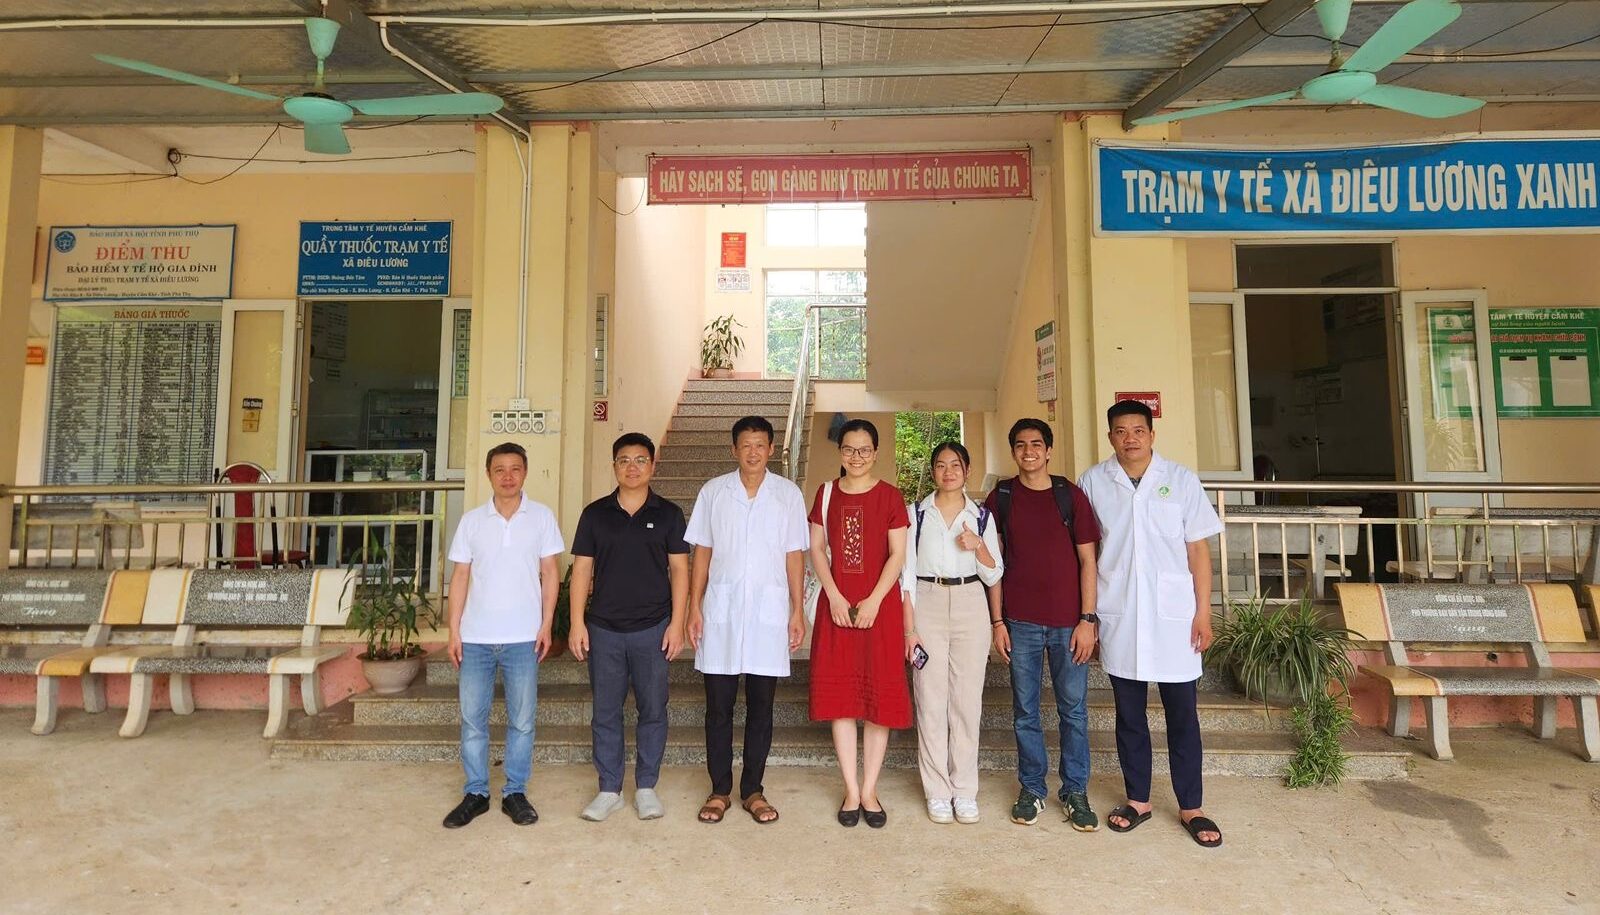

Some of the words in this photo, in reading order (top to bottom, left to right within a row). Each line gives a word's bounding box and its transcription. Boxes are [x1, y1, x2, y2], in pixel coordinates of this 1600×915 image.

[659, 166, 685, 192] HÃY
[688, 170, 724, 197] SẠCH
[752, 169, 778, 196] GỌN
[782, 164, 817, 192] GÀNG
[821, 168, 850, 192] NHƯ
[852, 168, 888, 196] TRẠM
[892, 168, 900, 190] Y
[904, 160, 920, 190] TẾ
[923, 158, 950, 189] CỦA
[954, 161, 1000, 188] CHÚNG
[1003, 165, 1020, 188] TA
[1122, 169, 1204, 224] TRẠM
[1212, 169, 1231, 213] Y
[1239, 158, 1273, 213] TẾ
[1282, 161, 1322, 214] XÃ
[1331, 158, 1398, 213] ĐIÊU
[1408, 160, 1508, 212] LƯƠNG
[1516, 162, 1598, 210] XANH
[185, 229, 200, 237] THỌ
[399, 222, 413, 232] CẨM
[96, 239, 144, 260] ĐIỂM
[151, 246, 191, 260] THU
[302, 234, 337, 256] QUẦY
[339, 235, 382, 254] THUỐC
[384, 240, 418, 256] TRẠM
[423, 240, 432, 253] Y
[433, 234, 448, 253] TẾ
[66, 264, 88, 273] BẢO
[91, 262, 120, 273] HIỂM
[133, 262, 148, 273] TẾ
[149, 264, 164, 275] HỘ
[167, 264, 187, 273] GIA
[189, 264, 217, 272] ĐÌNH
[342, 257, 355, 268] XÃ
[357, 257, 378, 268] ĐIÊU
[380, 257, 408, 268] LƯƠNG
[114, 310, 139, 319] BẢNG
[142, 309, 157, 318] GIÁ
[159, 309, 190, 318] THUỐC
[1570, 311, 1584, 319] KHÊ
